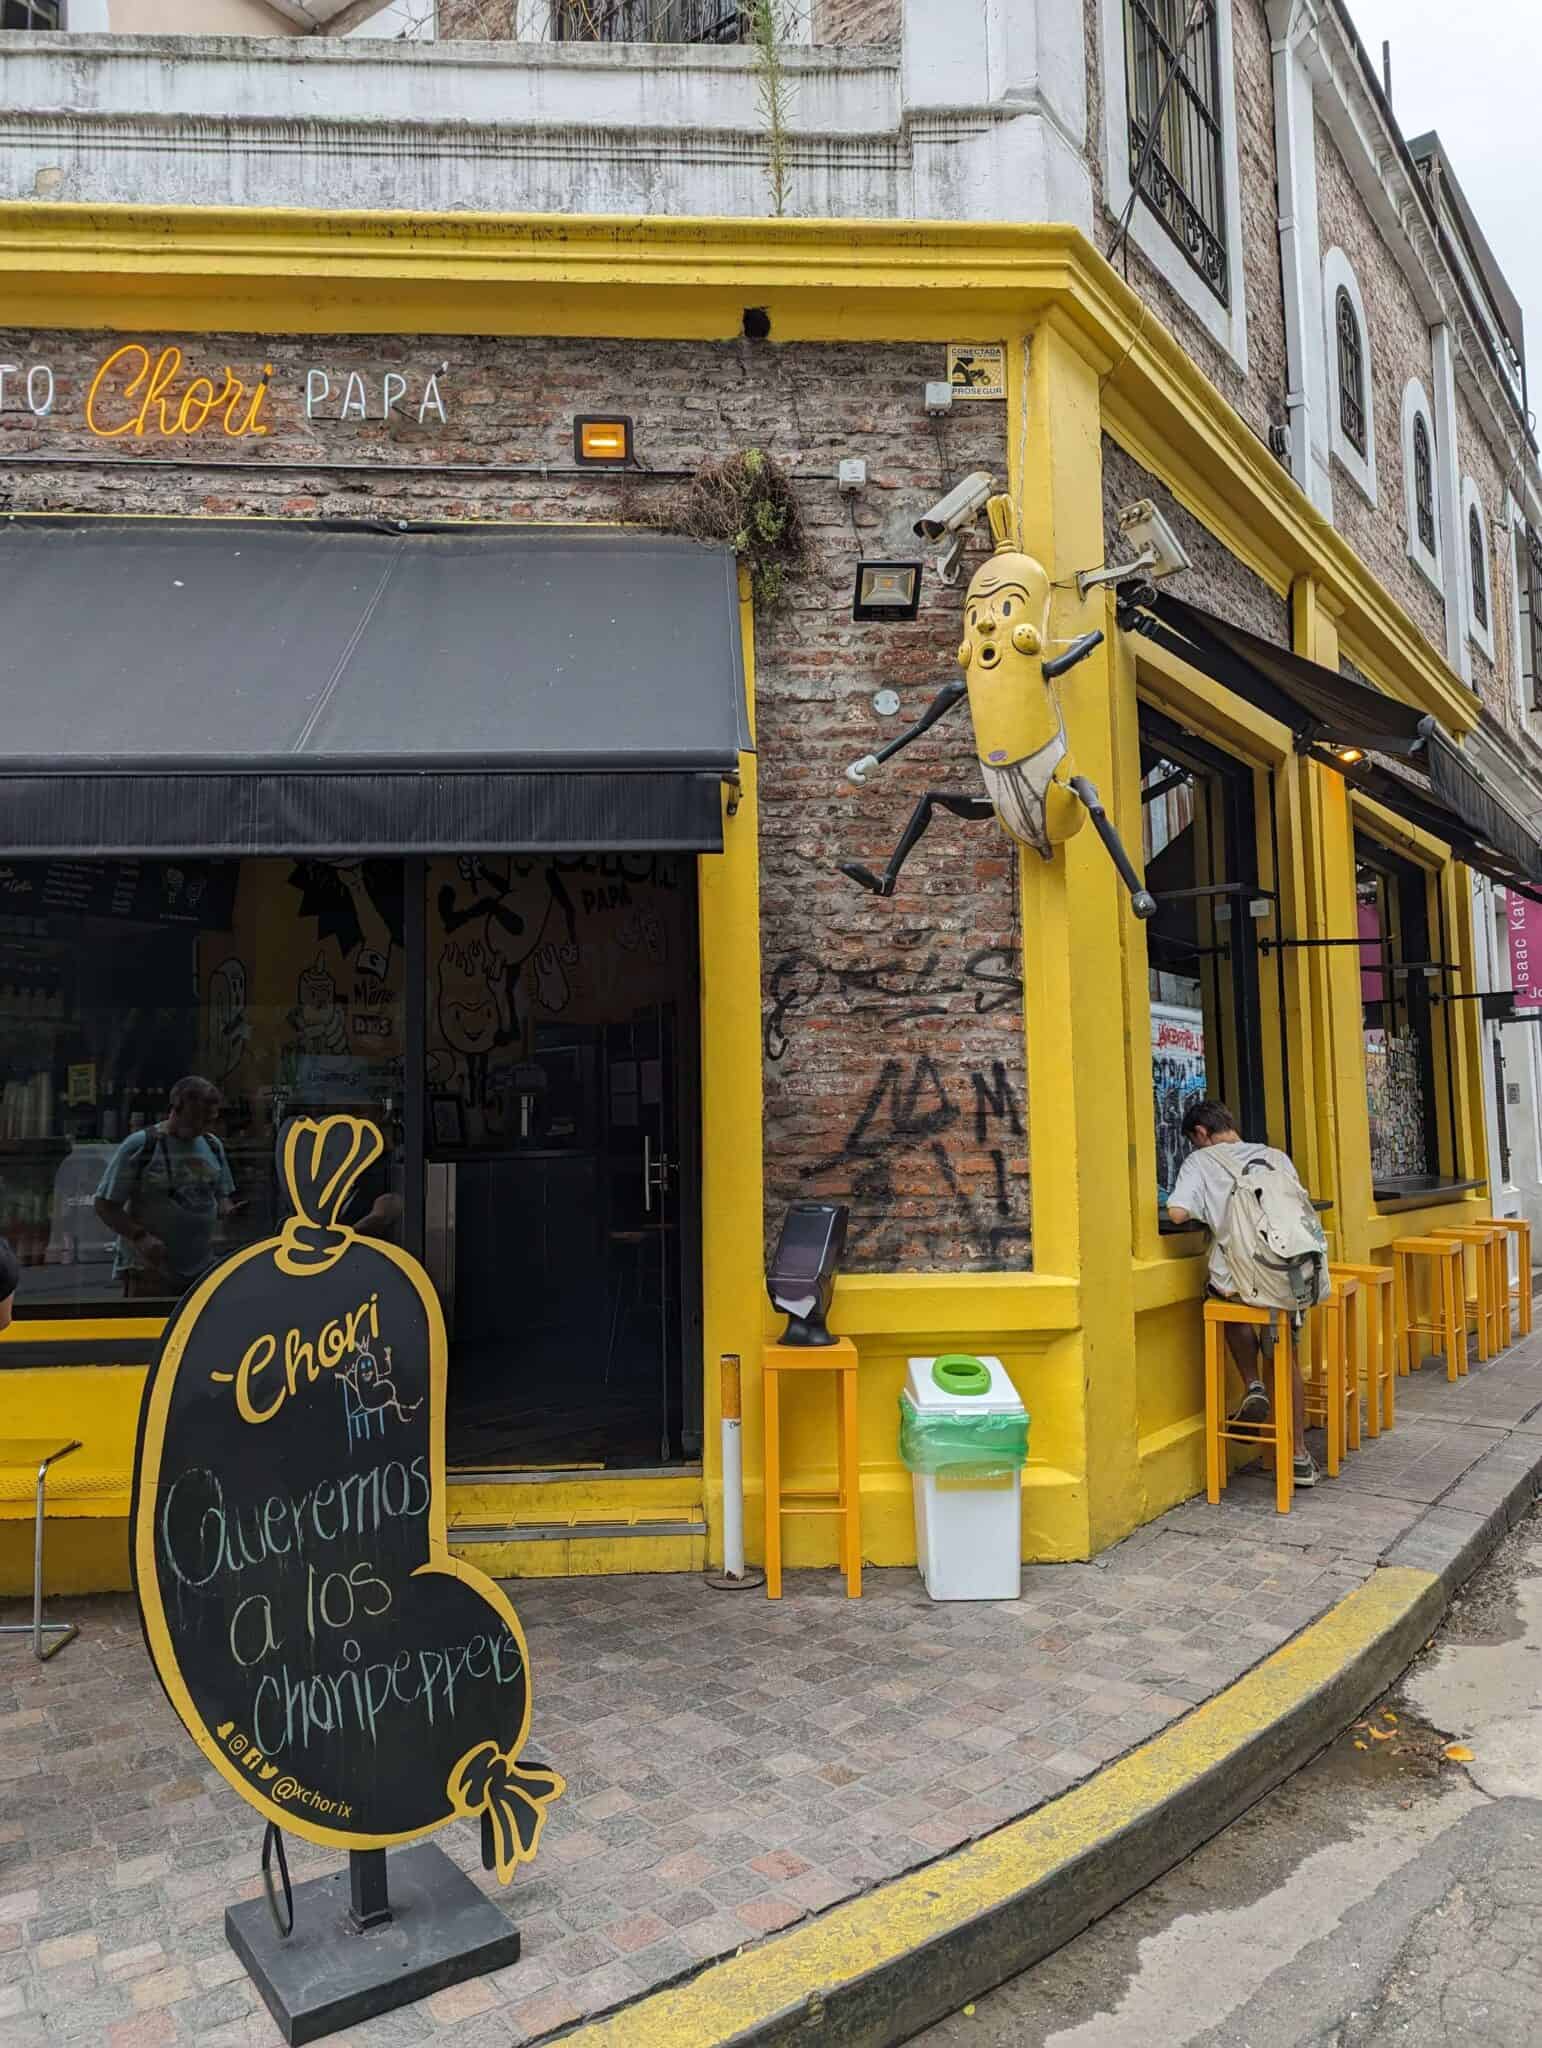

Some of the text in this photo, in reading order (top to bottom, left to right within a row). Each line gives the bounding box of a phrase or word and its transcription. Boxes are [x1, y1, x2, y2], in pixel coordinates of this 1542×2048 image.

[951, 347, 1001, 355] CONECTADA
[85, 344, 273, 437] Chori
[951, 387, 1002, 395] PROSEGUR
[1514, 938, 1529, 989] Isaac
[162, 1455, 430, 1586] Queremos
[229, 1561, 392, 1667] a los
